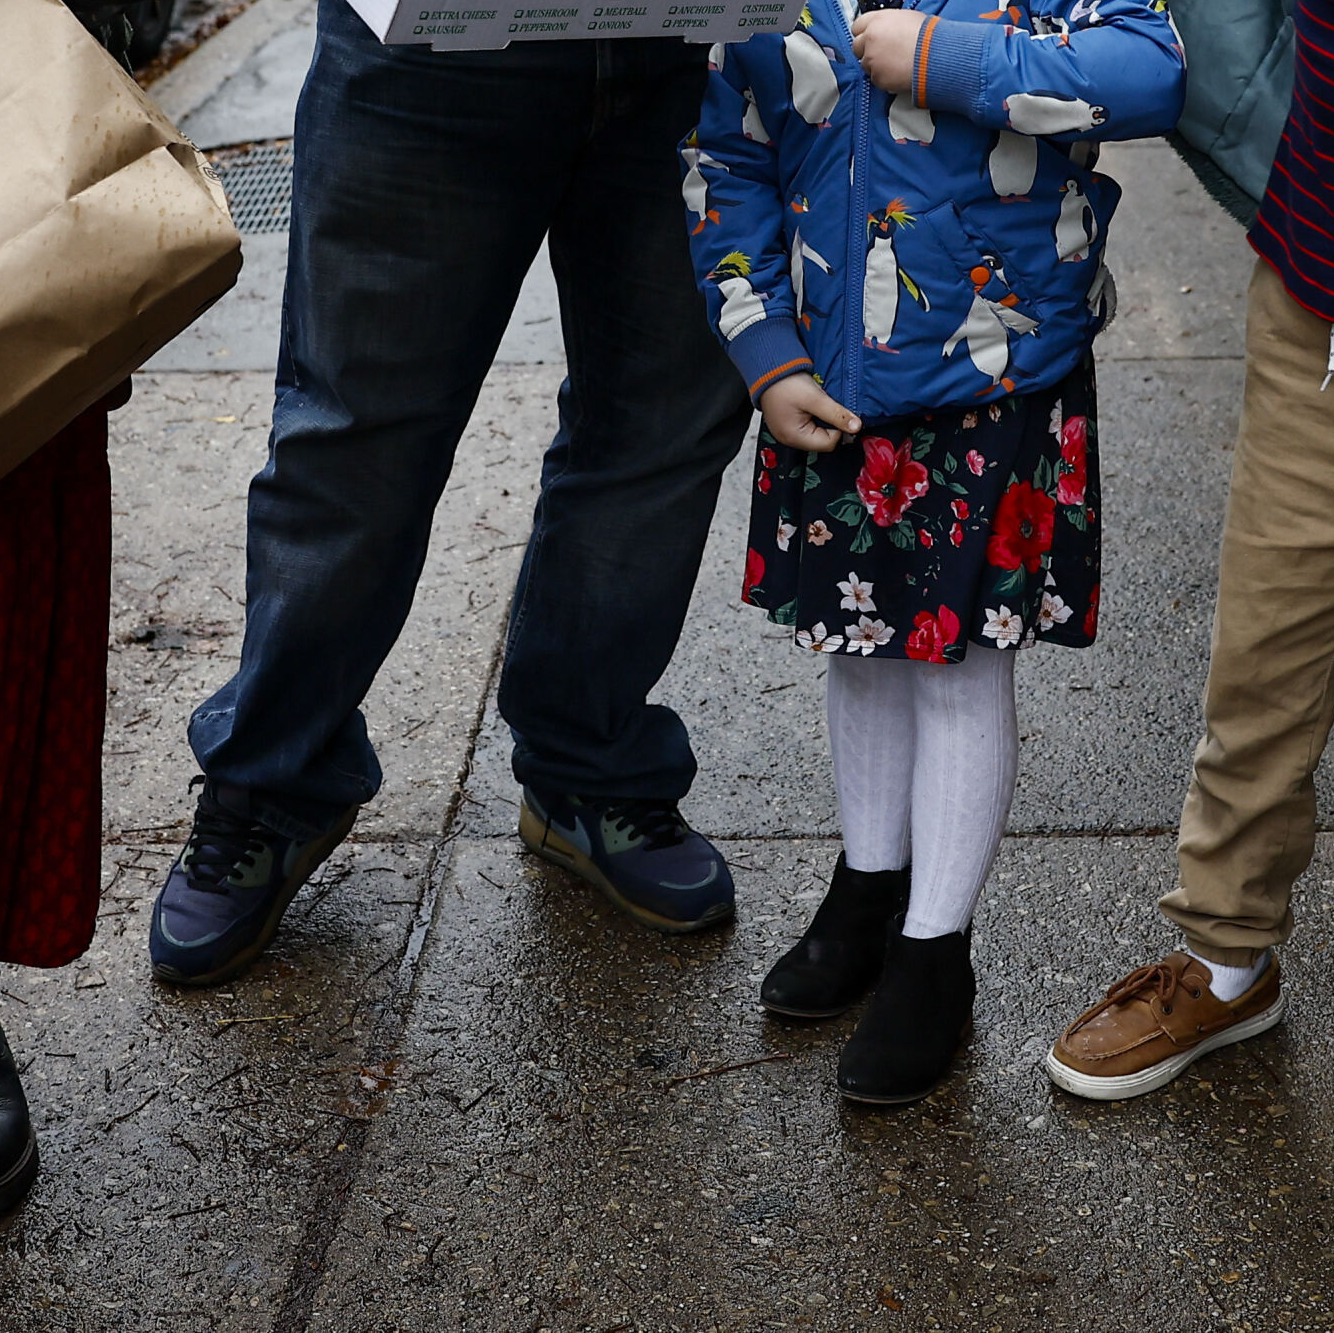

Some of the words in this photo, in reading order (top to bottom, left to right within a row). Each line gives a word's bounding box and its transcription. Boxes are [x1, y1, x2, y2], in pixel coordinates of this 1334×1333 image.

[523, 8, 578, 18] MUSHROOM
[605, 6, 647, 16] MEATBALL
[677, 5, 726, 14] ANCHOVIES
[742, 4, 785, 13] CUSTOMER
[430, 11, 460, 20] EXTRA
[461, 10, 498, 20] CHEESE
[598, 21, 632, 30] ONIONS
[671, 19, 709, 28] PEPPERS
[747, 17, 778, 26] SPECIAL
[425, 25, 467, 34] SAUSAGE
[518, 22, 569, 32] PEPPERONI
